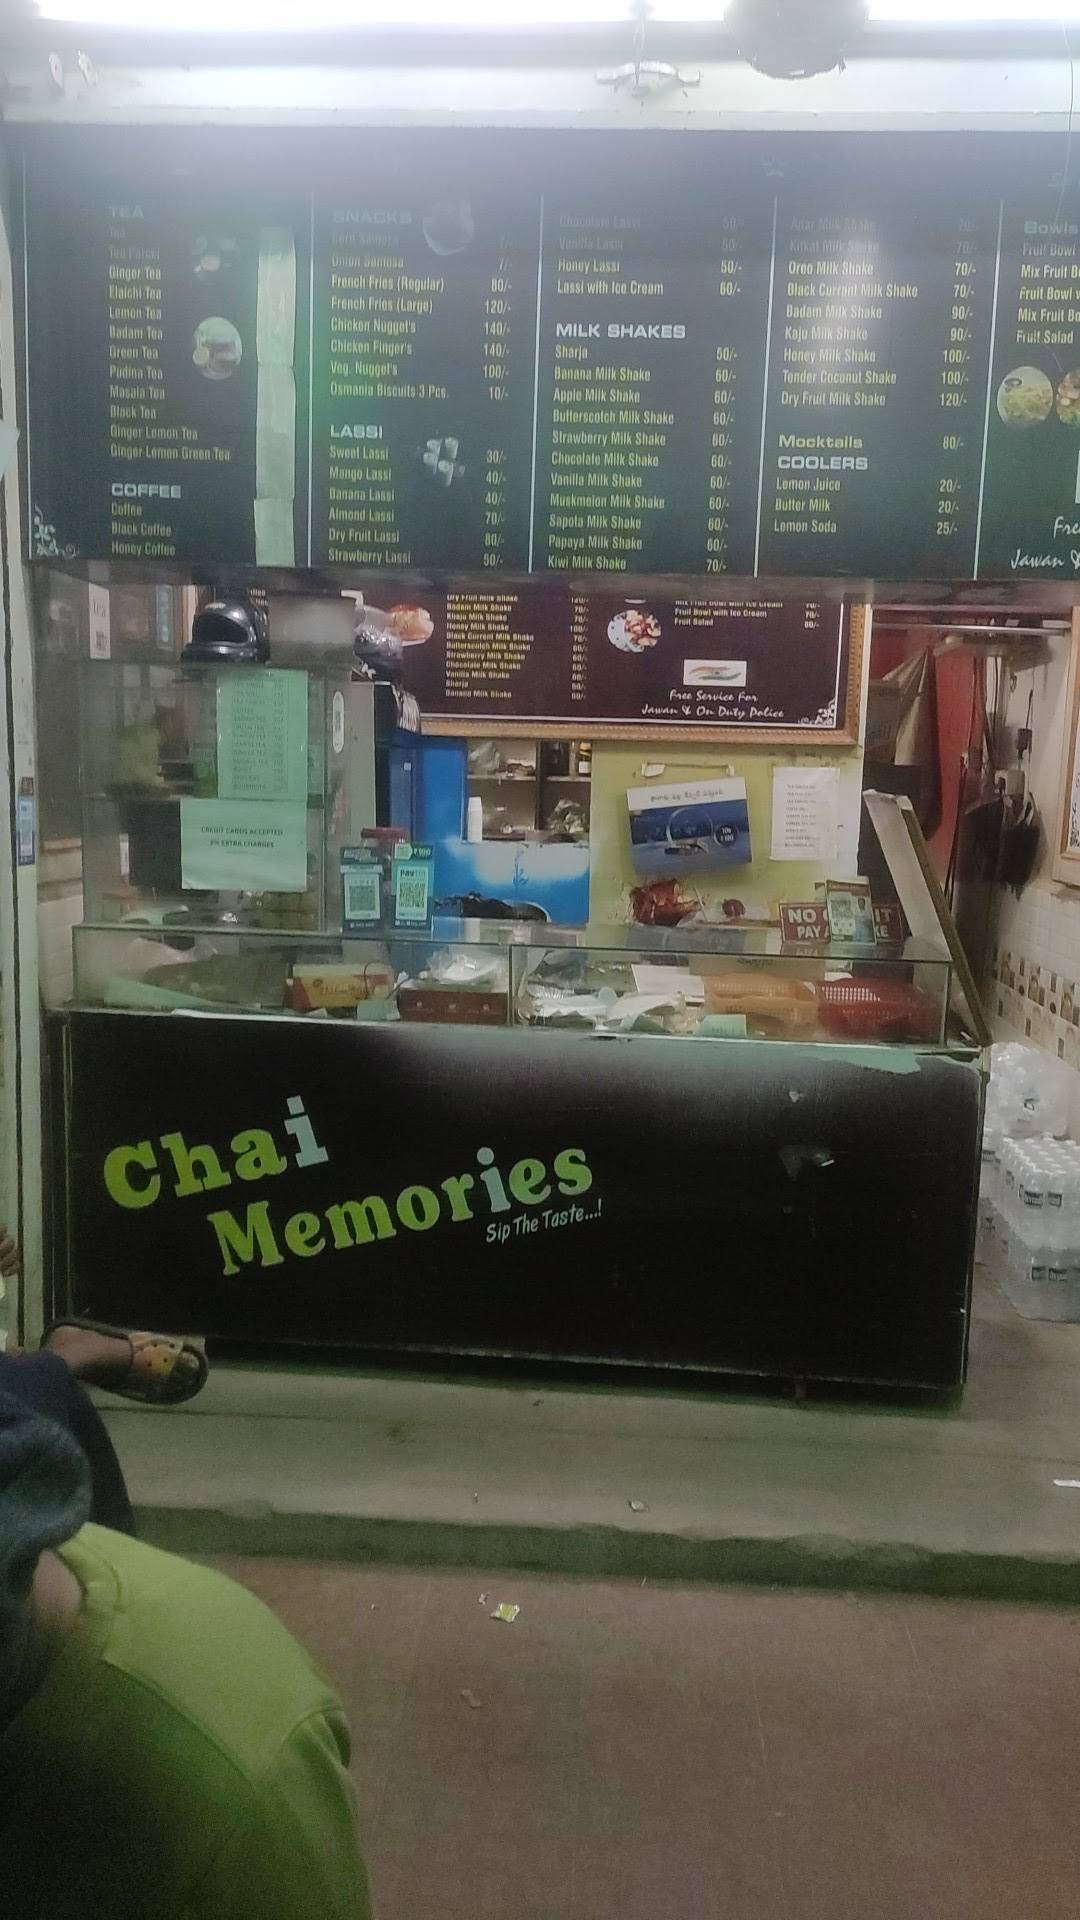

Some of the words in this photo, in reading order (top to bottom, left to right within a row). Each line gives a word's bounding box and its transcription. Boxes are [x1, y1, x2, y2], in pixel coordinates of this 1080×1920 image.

[1024, 221, 1078, 233] Bowls
[558, 259, 590, 274] Honey
[593, 260, 620, 272] Lassi
[721, 261, 742, 274] 50/-
[788, 262, 813, 275] Oreo
[817, 262, 838, 275] Milk
[841, 262, 873, 276] Shake
[955, 264, 976, 277] 70/-
[1021, 265, 1040, 278] Mix
[1043, 265, 1067, 278] Fruit
[558, 280, 584, 294] Lassi
[587, 281, 608, 294] with
[611, 282, 627, 295] Ice
[630, 282, 664, 295] Cream
[720, 283, 741, 296] 60/-
[1019, 287, 1043, 300] Fruit
[1047, 287, 1072, 300] Bowl
[787, 306, 822, 318] Badam
[825, 306, 847, 319] Milk
[850, 306, 882, 319] Shake
[952, 308, 973, 320] 90/-
[1018, 309, 1037, 322] Mix
[1041, 309, 1064, 322] Fruit
[556, 324, 600, 338] MILK
[607, 325, 686, 338] SHAKES
[1017, 330, 1040, 343] Fruit
[1044, 331, 1073, 344] Salad
[717, 348, 737, 361] 50/-
[783, 371, 817, 384] Tender
[820, 372, 862, 384] Coconut
[865, 372, 896, 385] Shake
[941, 372, 968, 385] 100/-
[782, 392, 799, 408] Dry
[802, 393, 825, 406] Fruit
[829, 393, 850, 406] Milk
[854, 393, 886, 406] Shake
[940, 394, 967, 407] 120/-
[553, 411, 616, 424] Butterscotch
[619, 412, 641, 425] Milk
[644, 412, 674, 425] Shake
[713, 412, 734, 425] 60/-
[330, 425, 382, 438] LASSI
[779, 435, 862, 449] Mocktails
[943, 437, 964, 450] 80/-
[552, 453, 601, 466] Chocolate
[604, 454, 625, 467] Milk
[628, 454, 659, 467] Shake
[711, 455, 732, 468] 60/-
[778, 456, 868, 469] COOLERS
[551, 474, 585, 487] Vanilla
[589, 475, 609, 487] Milk
[612, 475, 642, 488] Shake
[710, 477, 730, 489] 60/-
[777, 478, 810, 492] Lemon
[813, 478, 841, 491] Juice
[940, 480, 961, 492] 20/-
[112, 483, 181, 498] COFFEE
[776, 499, 806, 512] Butter
[809, 499, 830, 512] Milk
[938, 501, 959, 513] 20/-
[774, 520, 808, 533] Lemon
[811, 520, 837, 533] Soda
[937, 522, 957, 534] 25/-
[548, 557, 569, 569] Kiwi
[572, 557, 593, 569] Milk
[596, 558, 626, 571] Shake
[707, 560, 726, 572] 70/-
[1011, 549, 1064, 569] Jawan
[788, 909, 816, 923] NO
[797, 926, 821, 938] PAY
[103, 1095, 329, 1209] Chai
[207, 1147, 593, 1276] Memories
[485, 1221, 511, 1244] Sip
[512, 1213, 539, 1235] The
[543, 1198, 602, 1228] Taste...!
